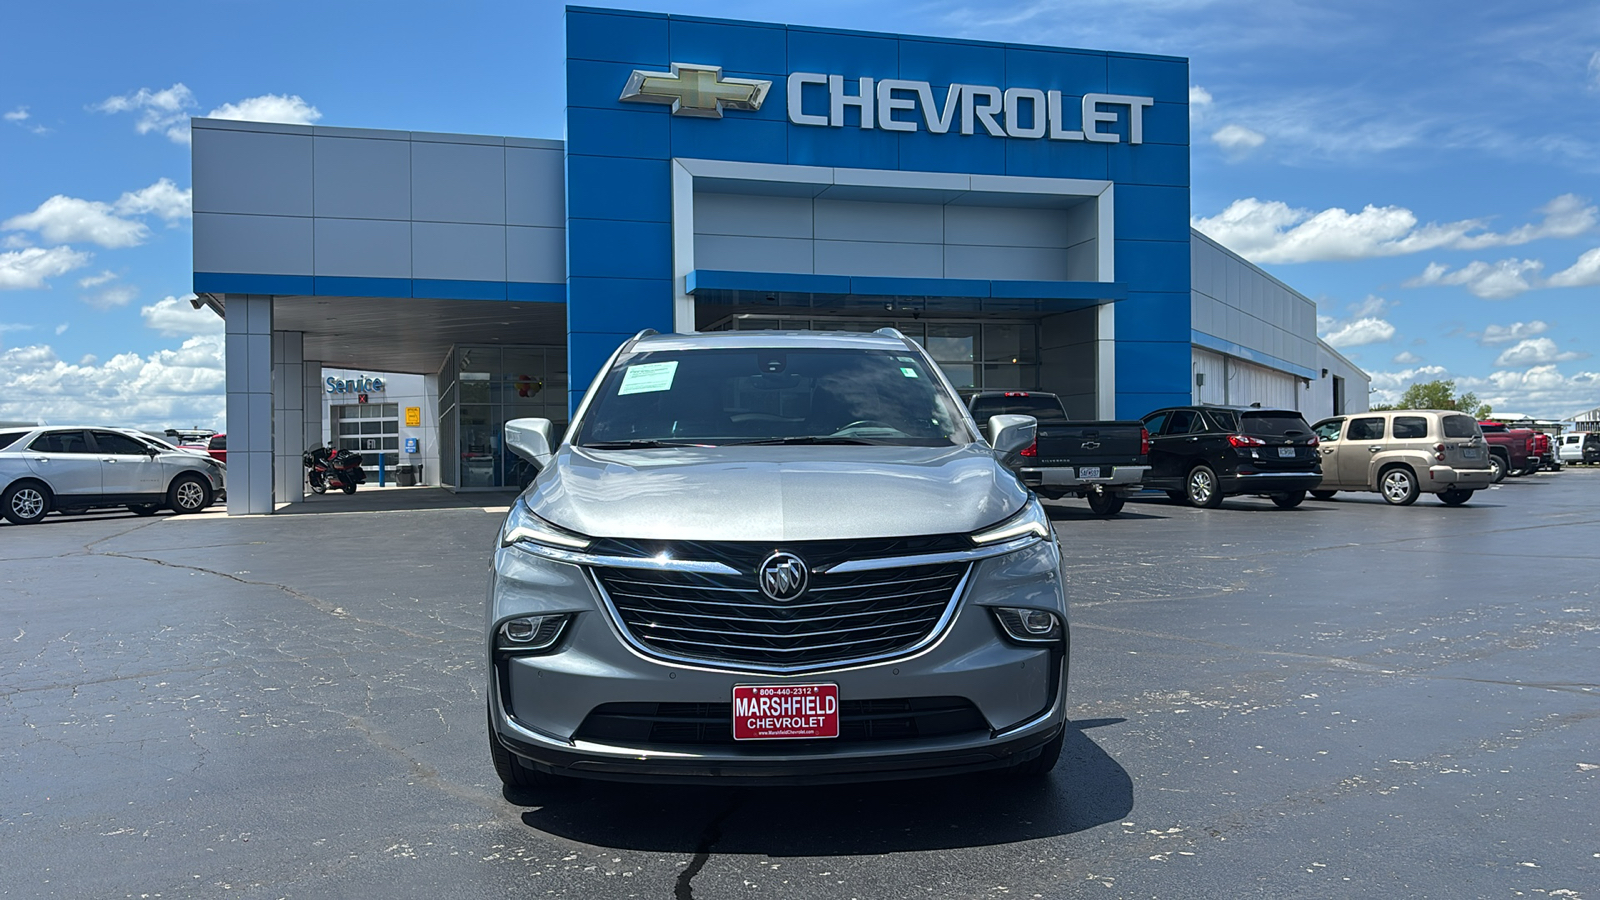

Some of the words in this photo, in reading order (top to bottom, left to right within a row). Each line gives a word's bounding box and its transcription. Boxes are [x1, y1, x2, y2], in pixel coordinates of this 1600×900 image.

[787, 71, 1154, 144] CHEVROLET
[326, 375, 383, 394] Service
[760, 688, 812, 696] 800-440-2312
[736, 695, 836, 717] MARSHFIELD
[747, 716, 826, 729] CHEVROLET
